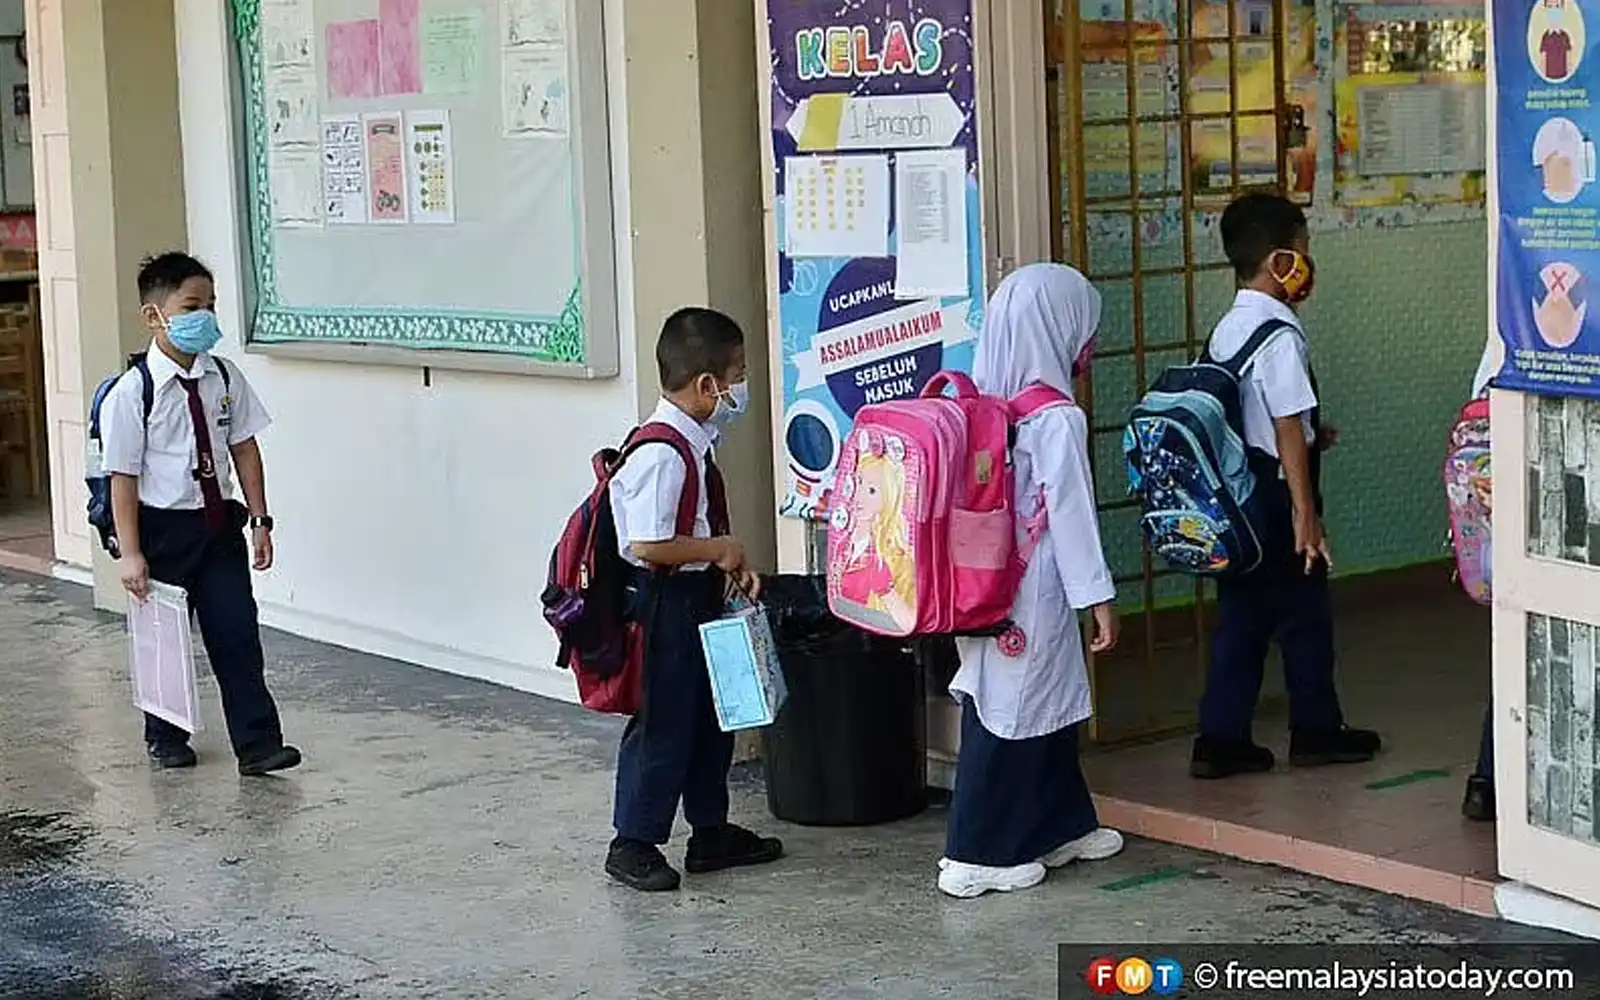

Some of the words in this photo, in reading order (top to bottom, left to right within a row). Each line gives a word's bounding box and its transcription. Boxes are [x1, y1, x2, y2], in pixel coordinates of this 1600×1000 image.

[797, 19, 942, 79] KELAS
[850, 104, 861, 139] 1
[865, 98, 932, 138] Amanah
[829, 280, 896, 313] UCAPKANL
[819, 310, 943, 365] ASSALAMUALAIKUM
[855, 355, 917, 387] SEBELUM
[865, 377, 914, 404] MASUK
